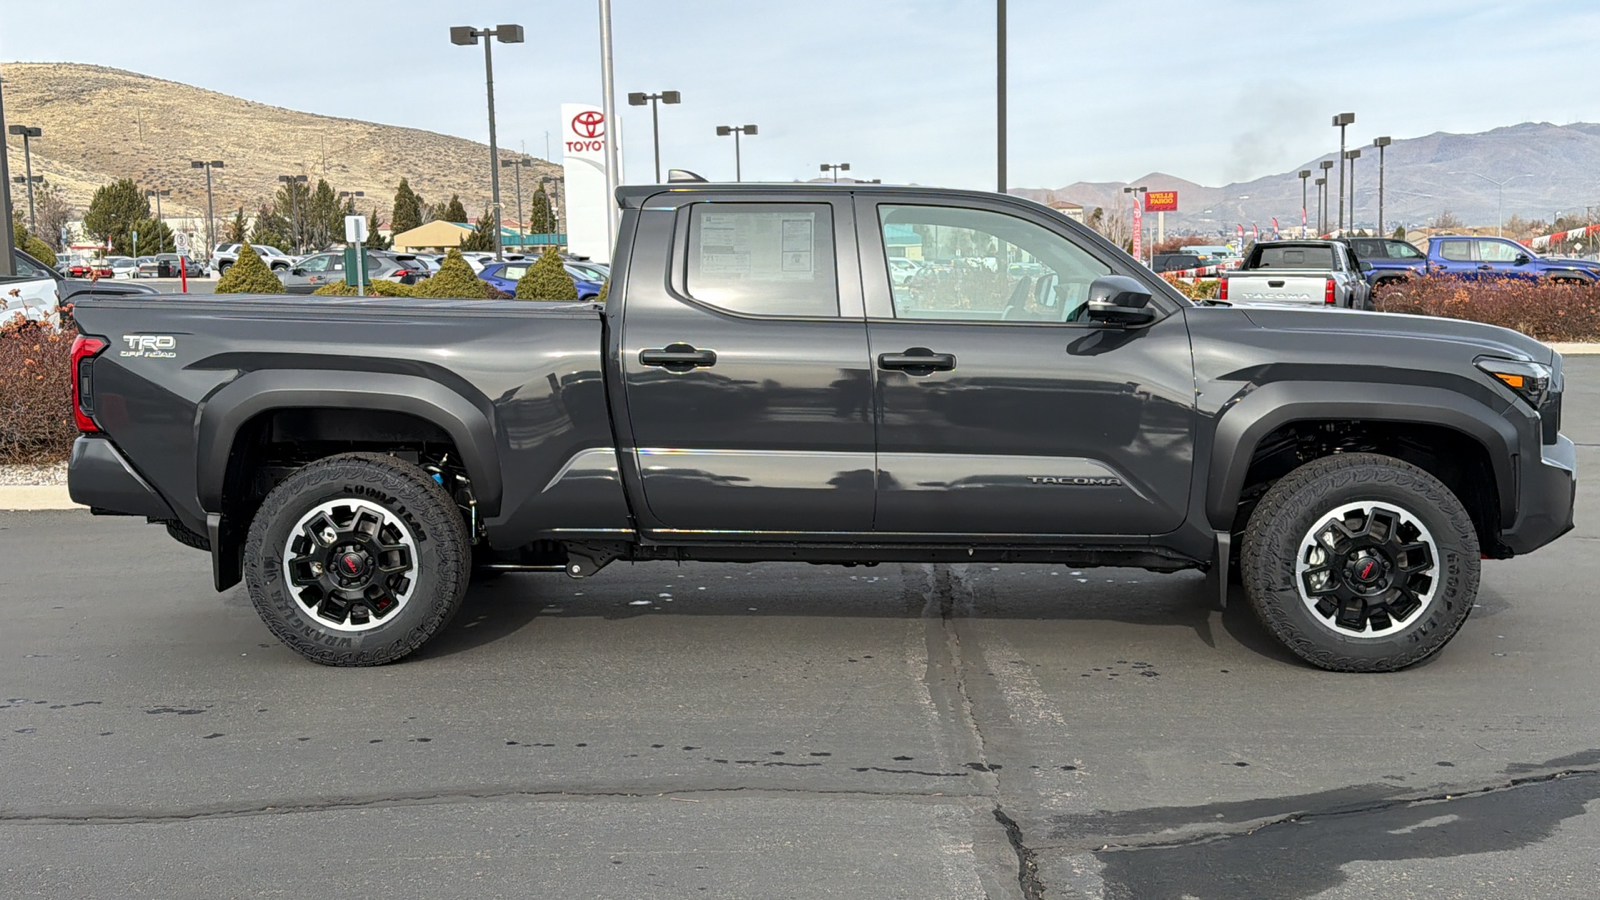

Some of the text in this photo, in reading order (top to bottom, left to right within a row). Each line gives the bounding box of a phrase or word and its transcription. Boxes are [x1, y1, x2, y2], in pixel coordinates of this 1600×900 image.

[566, 140, 606, 152] TOYO
[122, 335, 176, 350] TRD
[1026, 476, 1122, 486] TACOMA
